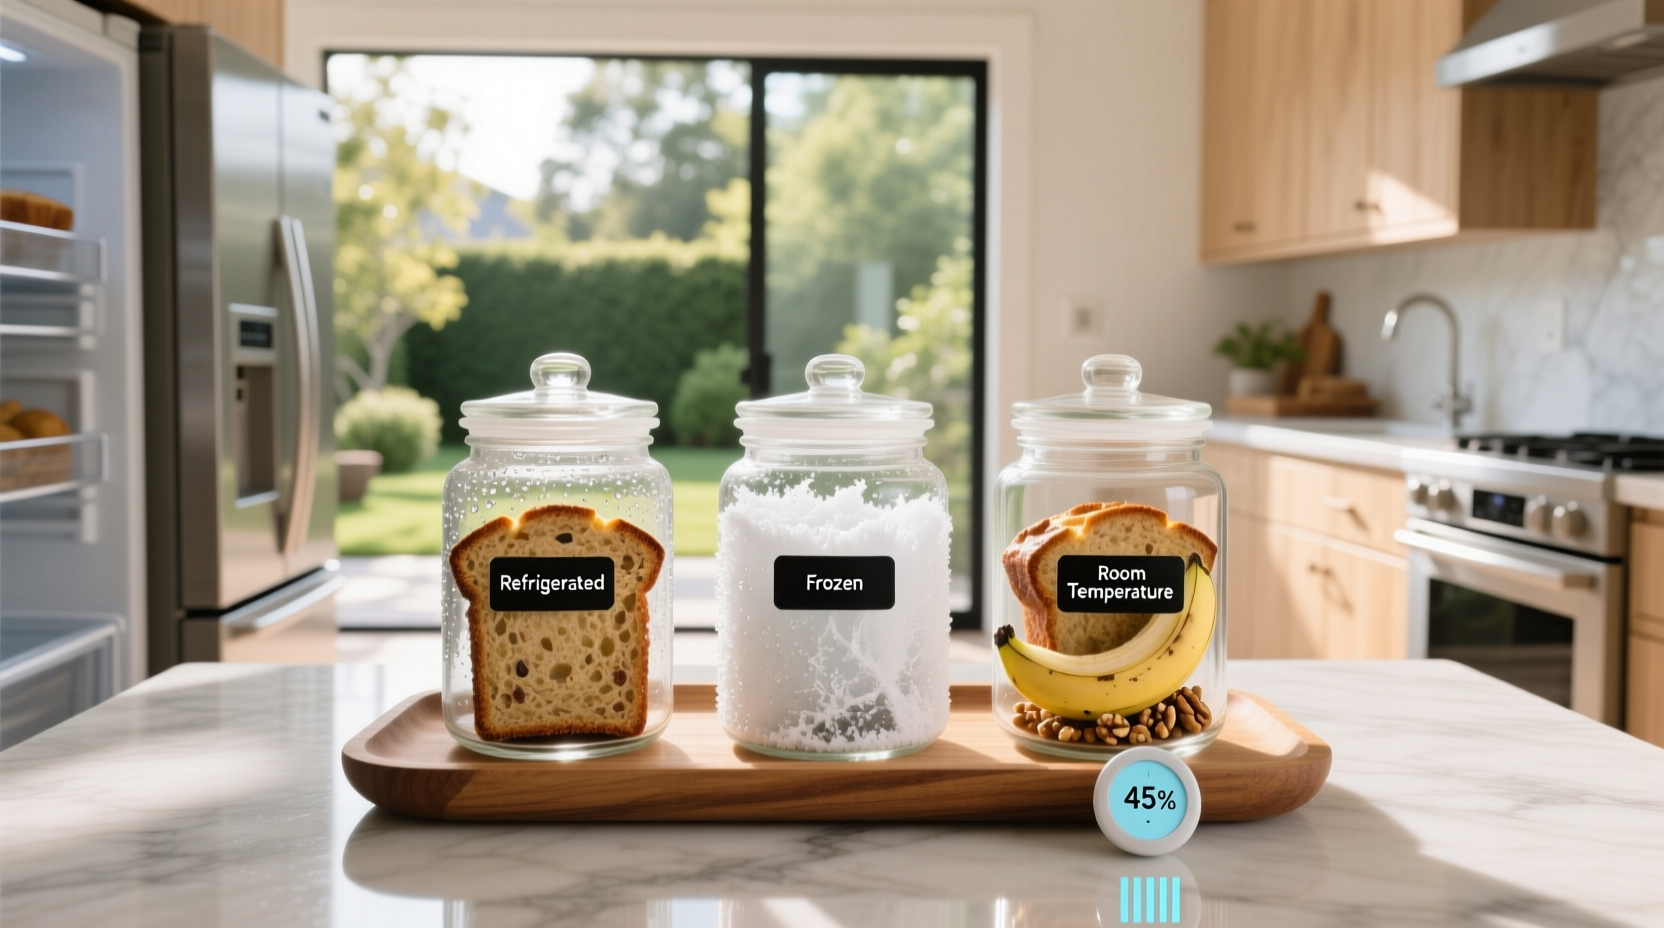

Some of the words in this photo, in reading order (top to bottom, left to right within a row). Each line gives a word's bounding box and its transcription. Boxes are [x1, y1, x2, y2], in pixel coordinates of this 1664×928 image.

[500, 573, 605, 594] Refrigerated
[806, 574, 863, 591] Frozen
[1098, 565, 1146, 581] Room
[1066, 582, 1174, 604] Temperature
[1123, 785, 1177, 810] 45%
